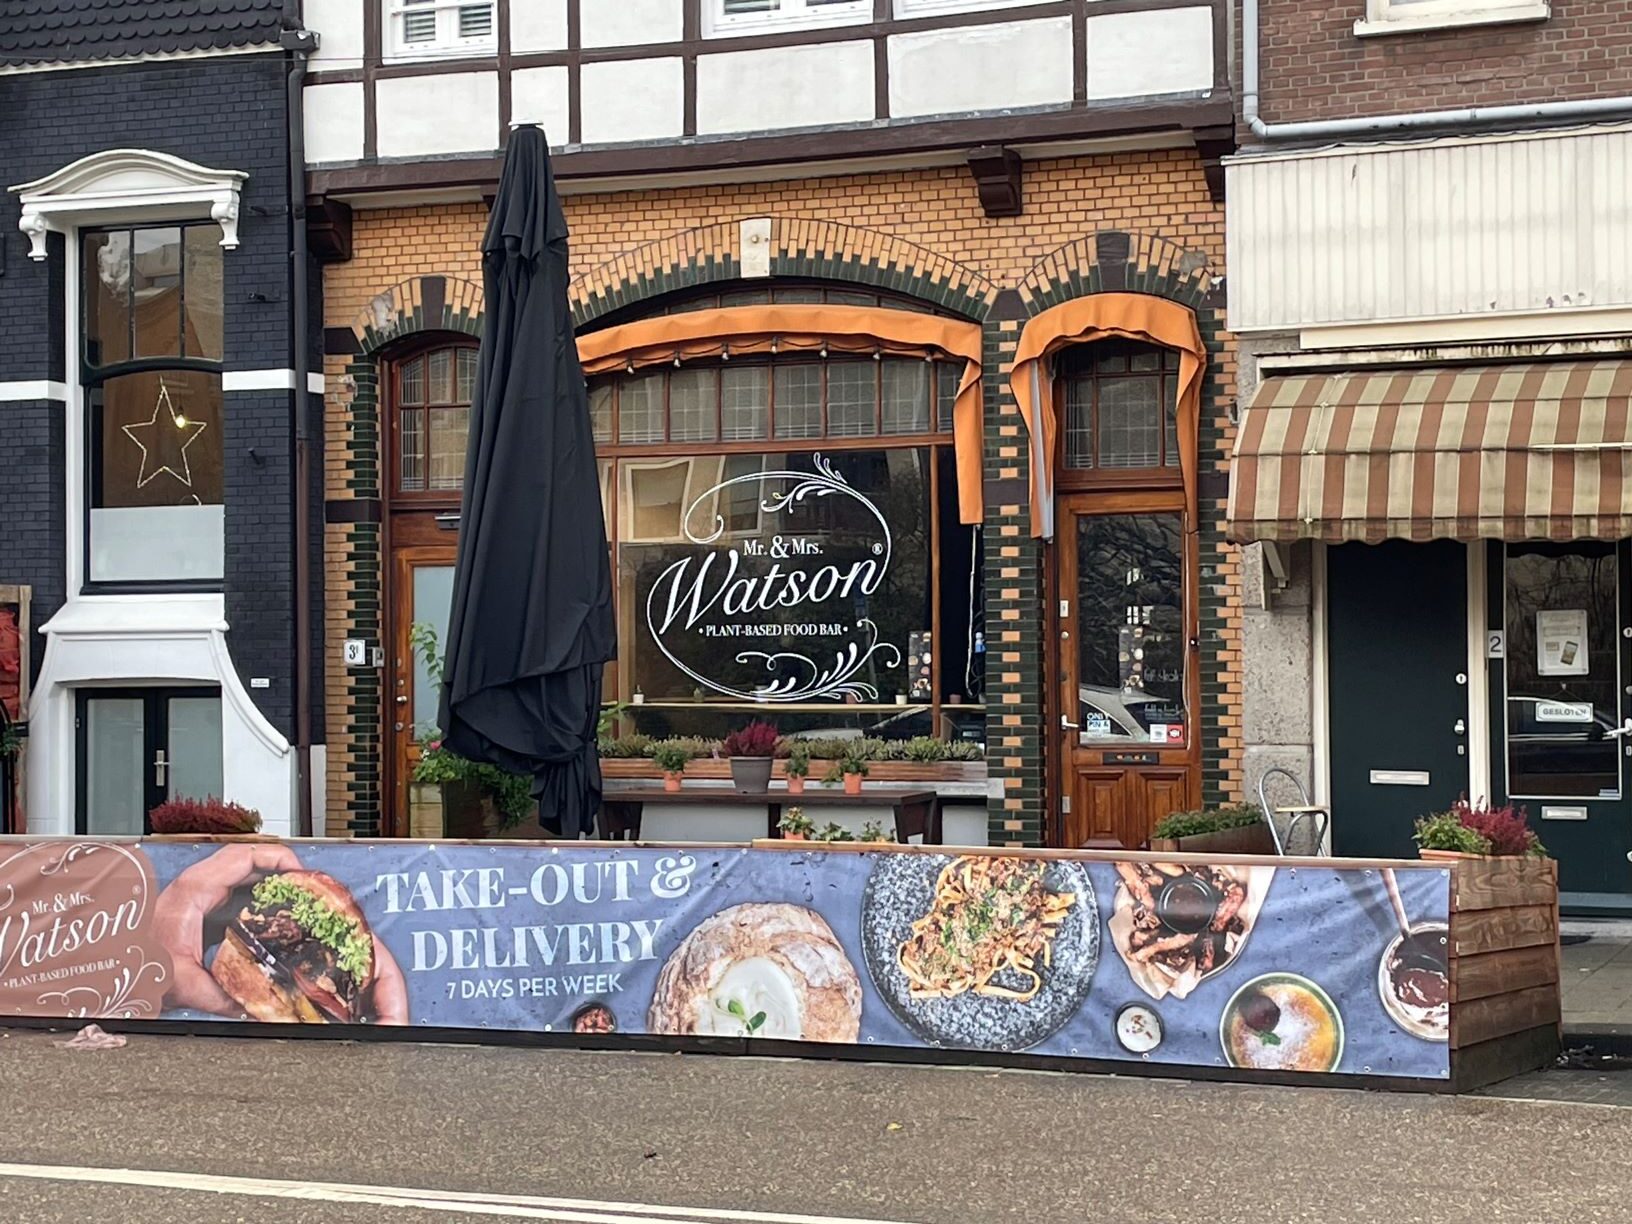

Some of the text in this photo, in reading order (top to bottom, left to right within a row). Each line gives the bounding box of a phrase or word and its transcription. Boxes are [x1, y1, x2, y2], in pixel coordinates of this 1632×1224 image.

[743, 535, 824, 558] Mr. & Mrs.
[658, 549, 879, 635] Watson
[706, 623, 843, 637] PLANT-BASED FOOD BAR
[1489, 636, 1502, 653] 2
[376, 855, 697, 914] TAKE-OUT &
[32, 891, 95, 915] Mr. & Mrs.
[411, 918, 664, 972] DELIVERY
[9, 958, 116, 988] PLANT-BASED FOOD BAR
[447, 972, 624, 1000] 7 DAYS PER WEEK
